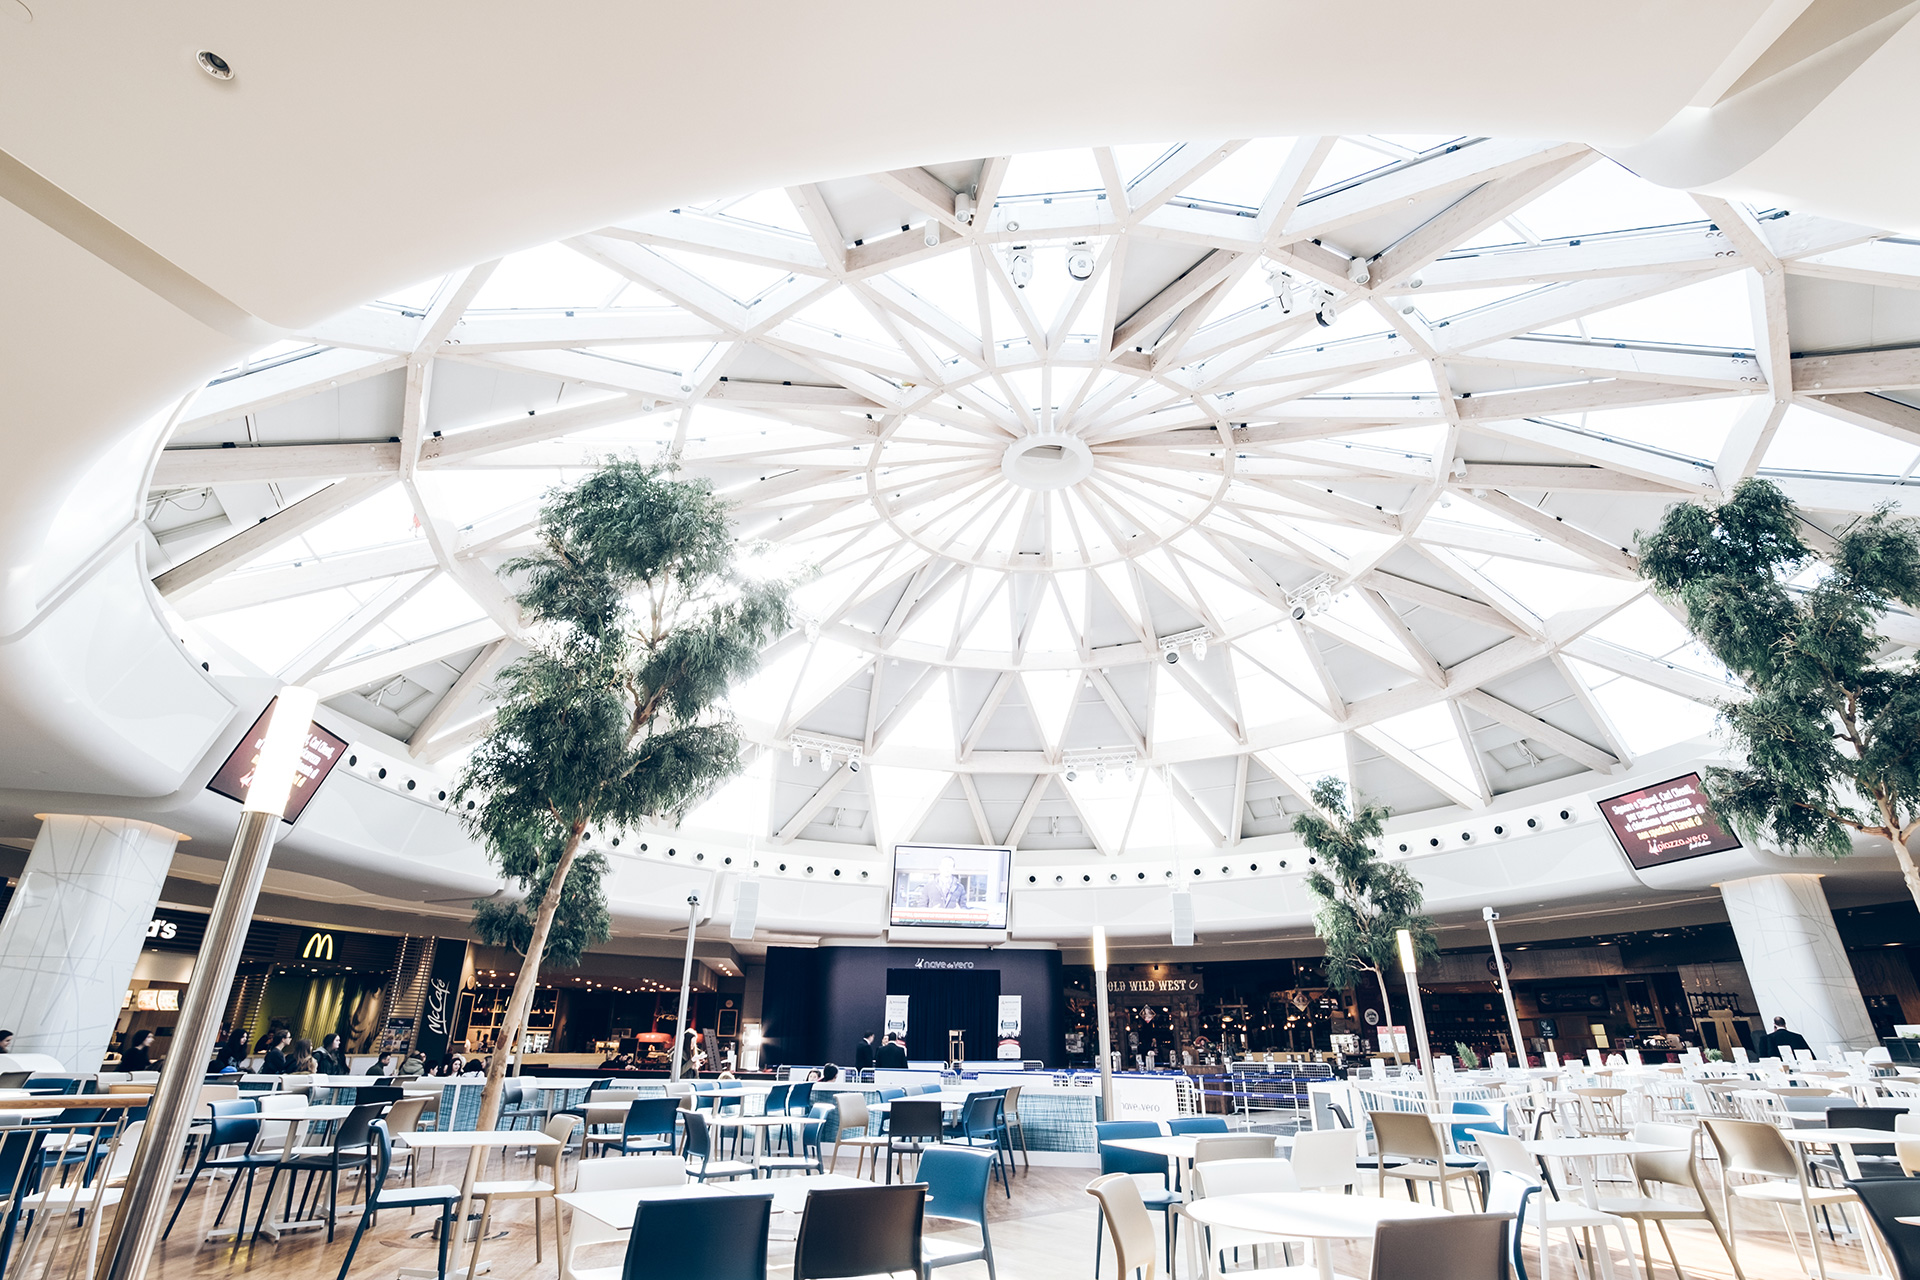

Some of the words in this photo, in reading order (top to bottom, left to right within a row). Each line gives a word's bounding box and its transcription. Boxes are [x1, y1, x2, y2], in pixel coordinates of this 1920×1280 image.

[1658, 838, 1686, 852] piazza
[1687, 833, 1709, 844] vero
[923, 961, 947, 969] nave
[953, 961, 974, 969] vero
[1107, 981, 1126, 992] OLD
[1129, 980, 1155, 992] WILD
[1158, 979, 1187, 991] WEST
[1140, 1103, 1160, 1113] vero
